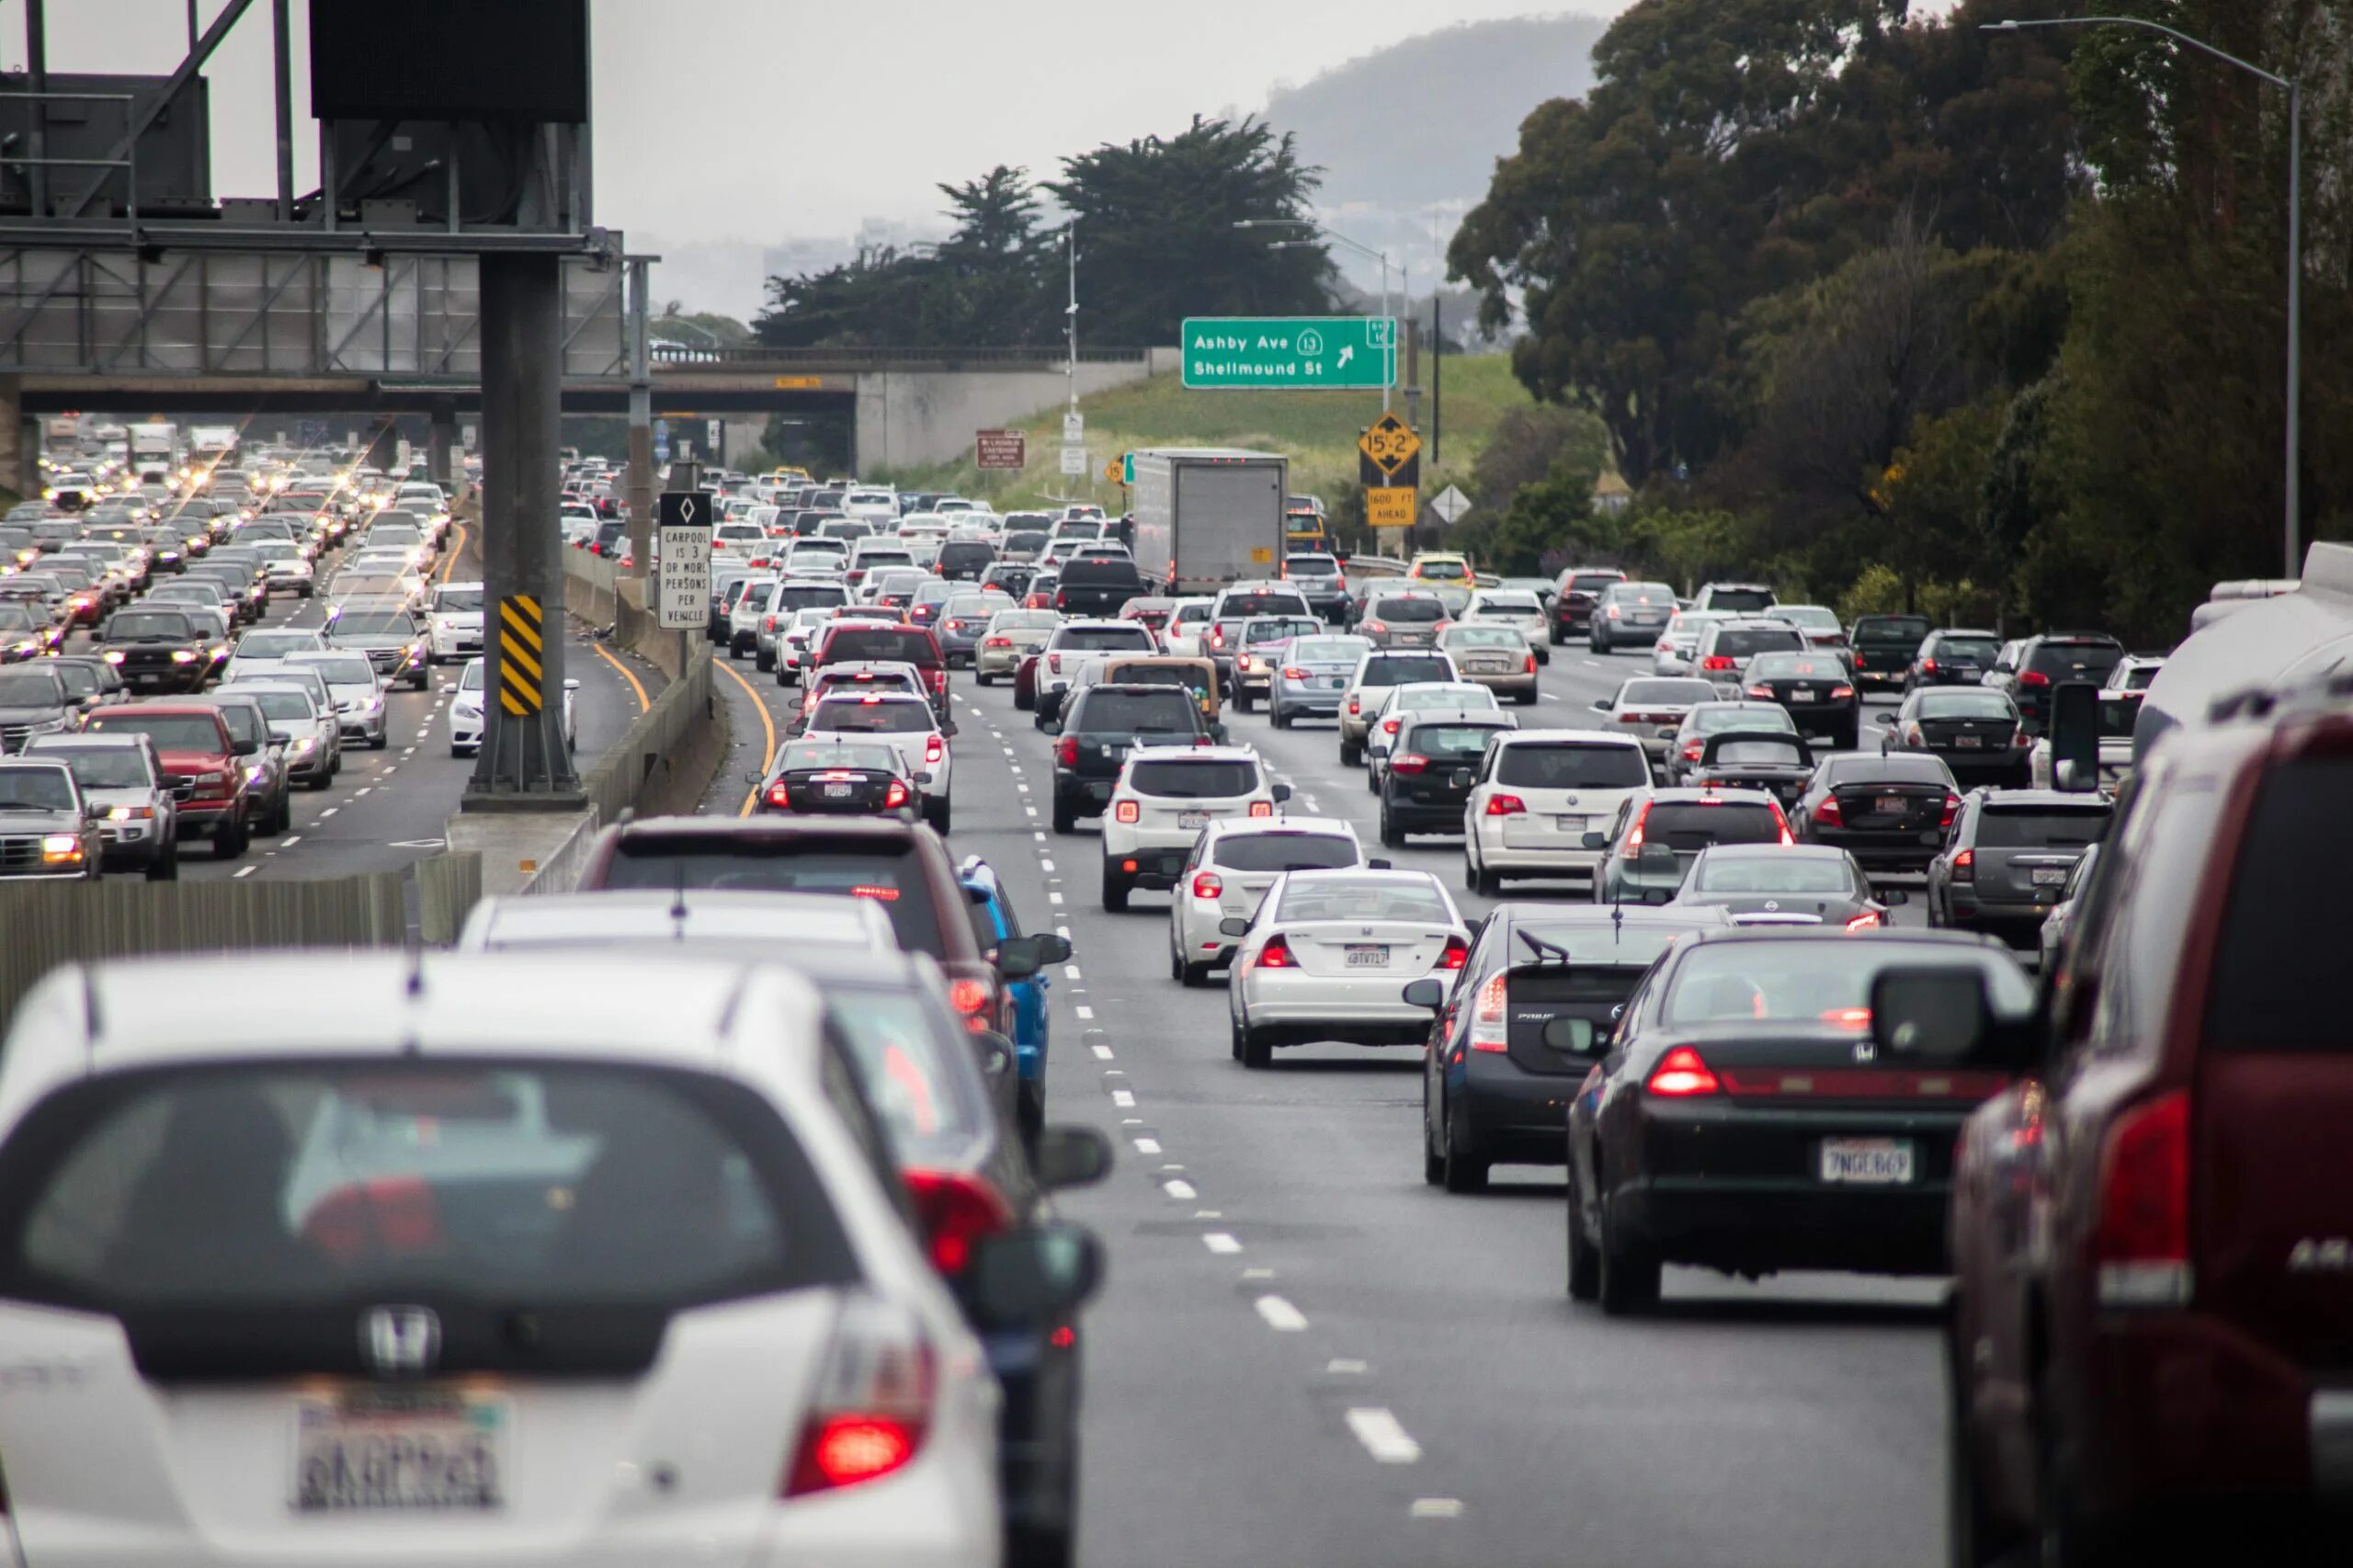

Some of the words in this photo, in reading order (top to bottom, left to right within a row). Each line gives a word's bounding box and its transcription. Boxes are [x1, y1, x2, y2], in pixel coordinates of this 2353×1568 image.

[1194, 335, 1247, 352] Ashby
[1257, 335, 1289, 348] Ave
[1303, 337, 1316, 351] 13
[1194, 361, 1296, 376] Shellmound
[1304, 362, 1323, 376] St
[1370, 494, 1392, 505] 1600
[1402, 494, 1412, 504] FT
[1377, 509, 1406, 519] AHEAD
[665, 531, 708, 543] CARPOOL
[676, 547, 685, 558] IS
[692, 546, 699, 558] 3
[665, 562, 678, 574] OR
[684, 562, 707, 574] MORE
[665, 577, 707, 590] PERSONS
[678, 595, 696, 606] PER
[668, 609, 704, 622] VEHICLE
